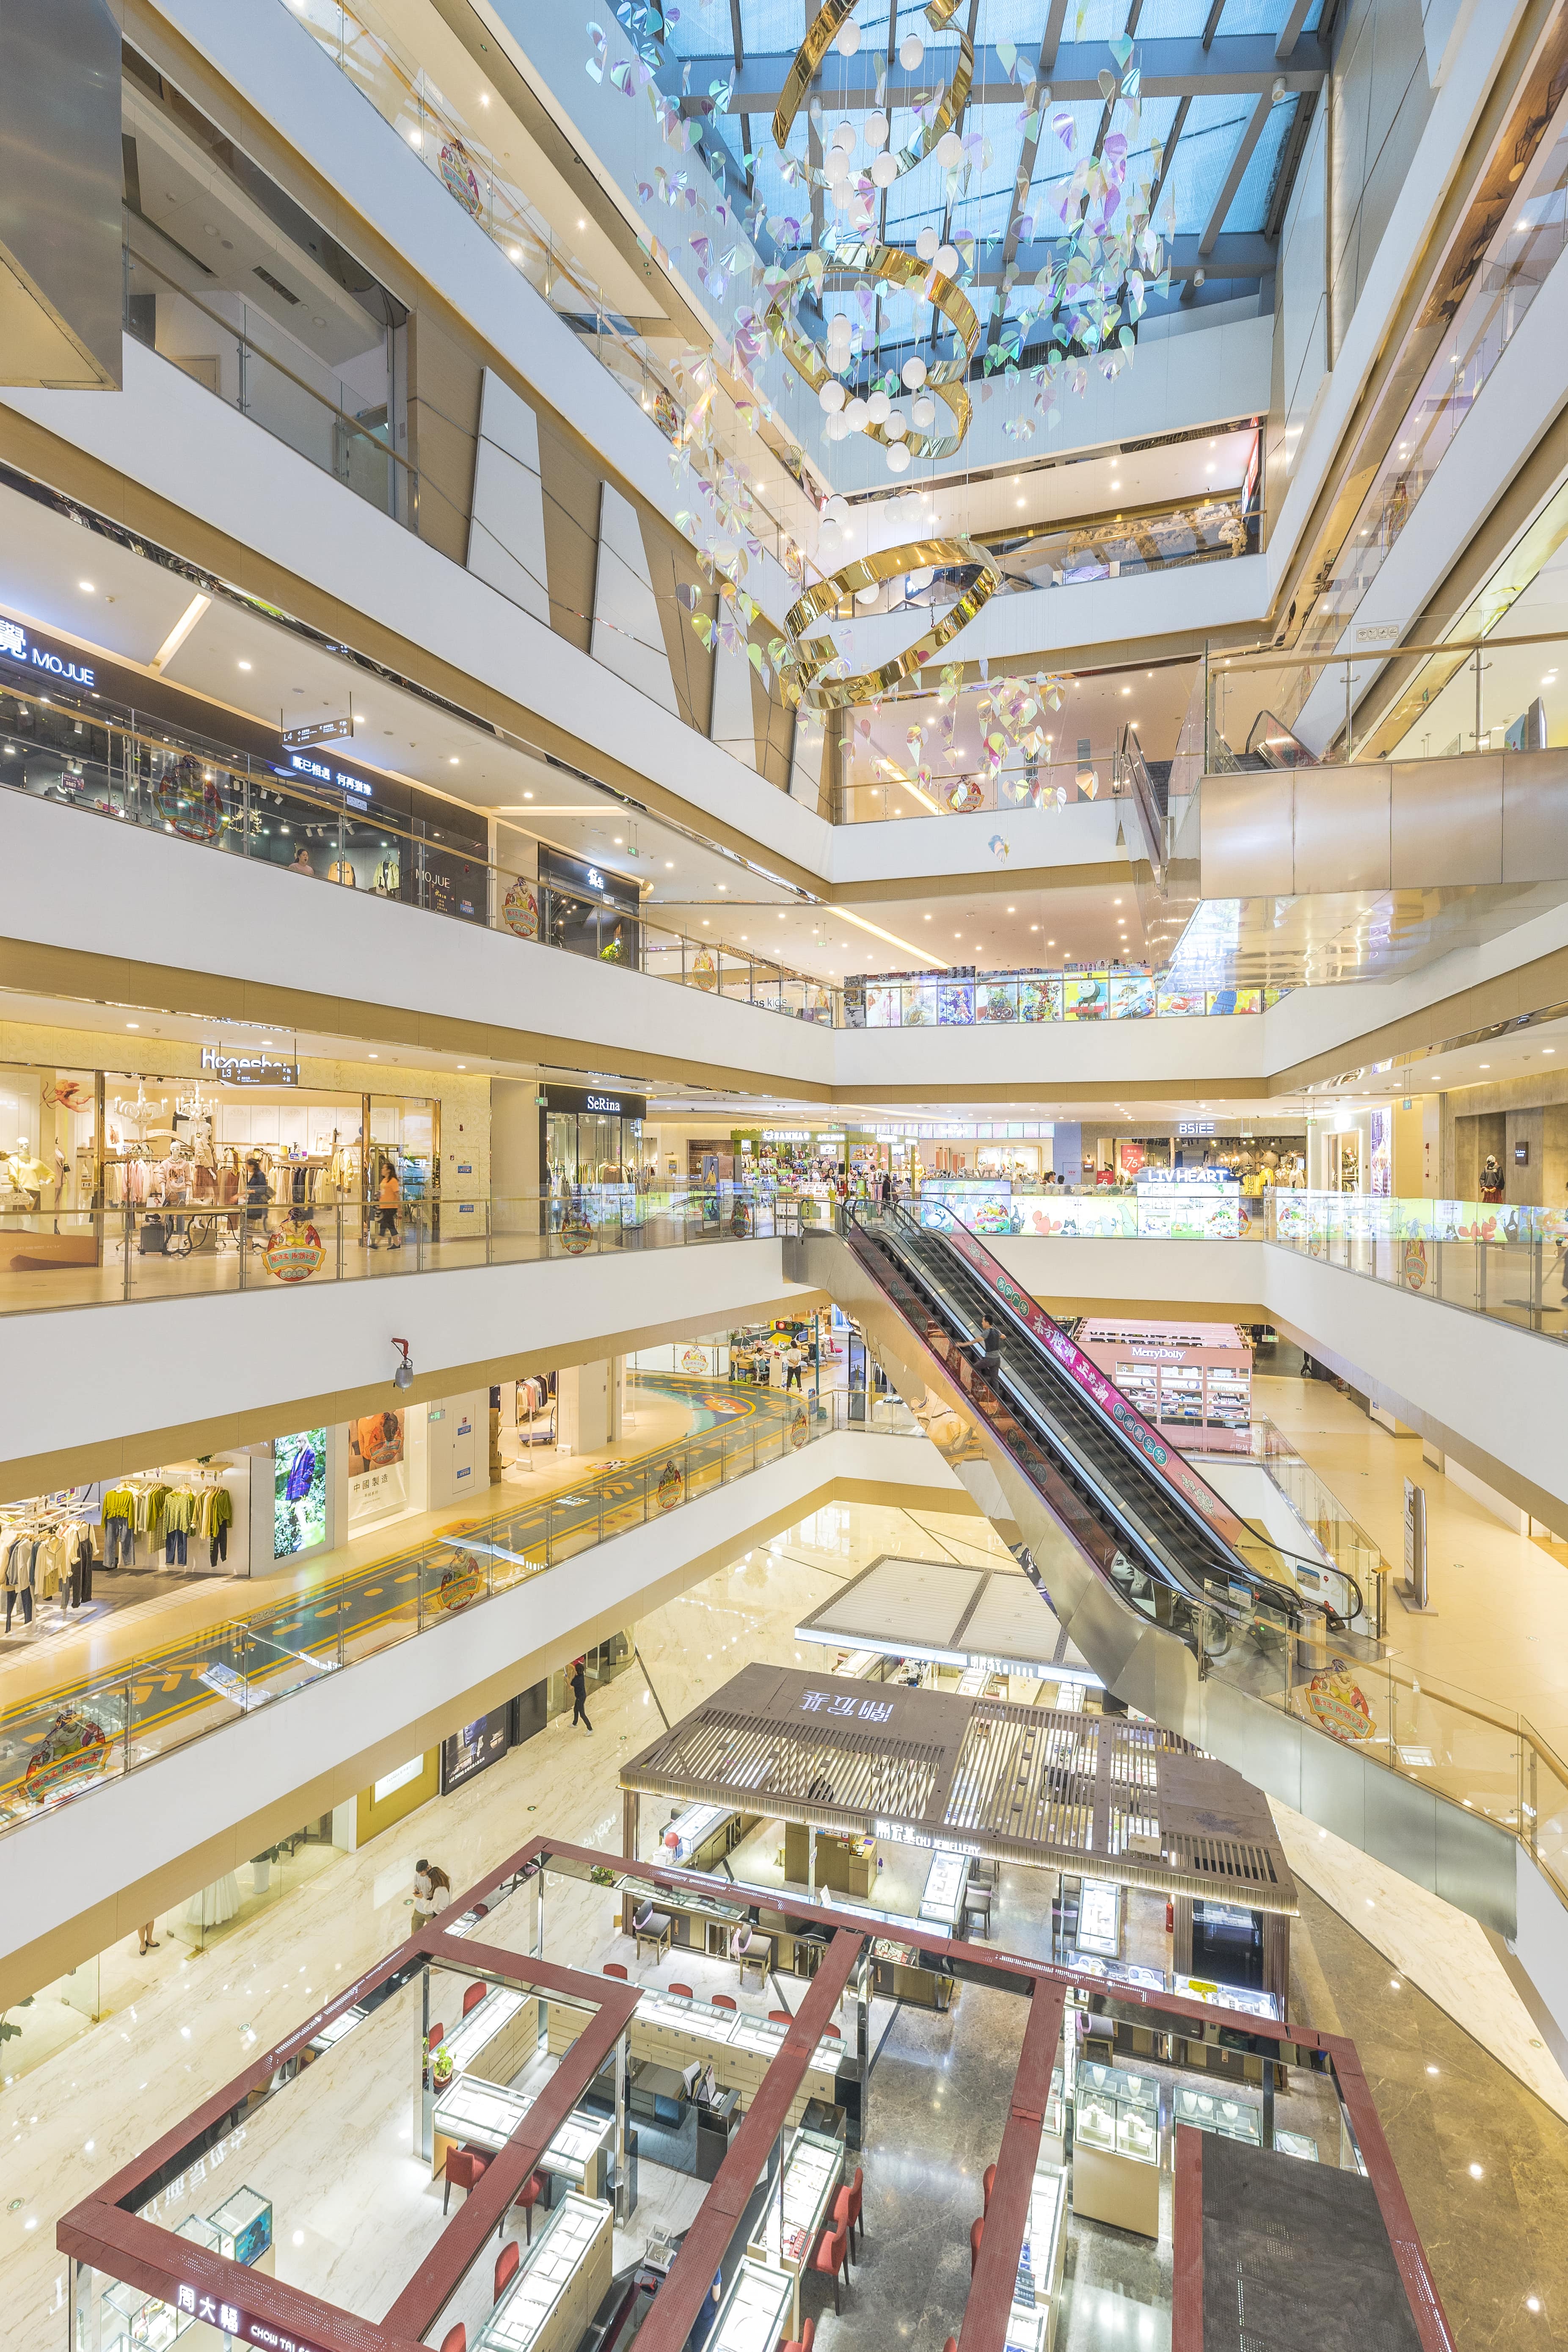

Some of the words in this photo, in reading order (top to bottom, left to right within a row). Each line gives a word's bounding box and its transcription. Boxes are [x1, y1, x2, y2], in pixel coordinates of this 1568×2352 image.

[32, 648, 94, 687] MOJUE
[284, 733, 292, 742] L4
[416, 869, 450, 889] MOJUE
[222, 1069, 231, 1077] L3
[587, 1096, 620, 1111] SeRina
[1148, 1170, 1175, 1183] LIV
[1176, 1170, 1228, 1183] HEART
[998, 1277, 1028, 1314] 苏宁广场
[1050, 1347, 1071, 1371] ORIENTAL
[1070, 1369, 1084, 1386] STYLE
[1132, 1347, 1186, 1361] MerryDolly
[1116, 1406, 1165, 1461] 国潮嘉年华
[353, 1473, 388, 1493] 中國製造
[799, 1691, 894, 1723] 潮宏基
[876, 1821, 915, 1846] 潮宏基
[932, 1839, 981, 1856] JEWELLERY
[178, 2284, 238, 2333] 周大福
[251, 2325, 278, 2346] CHOW
[279, 2337, 295, 2352] TAI
